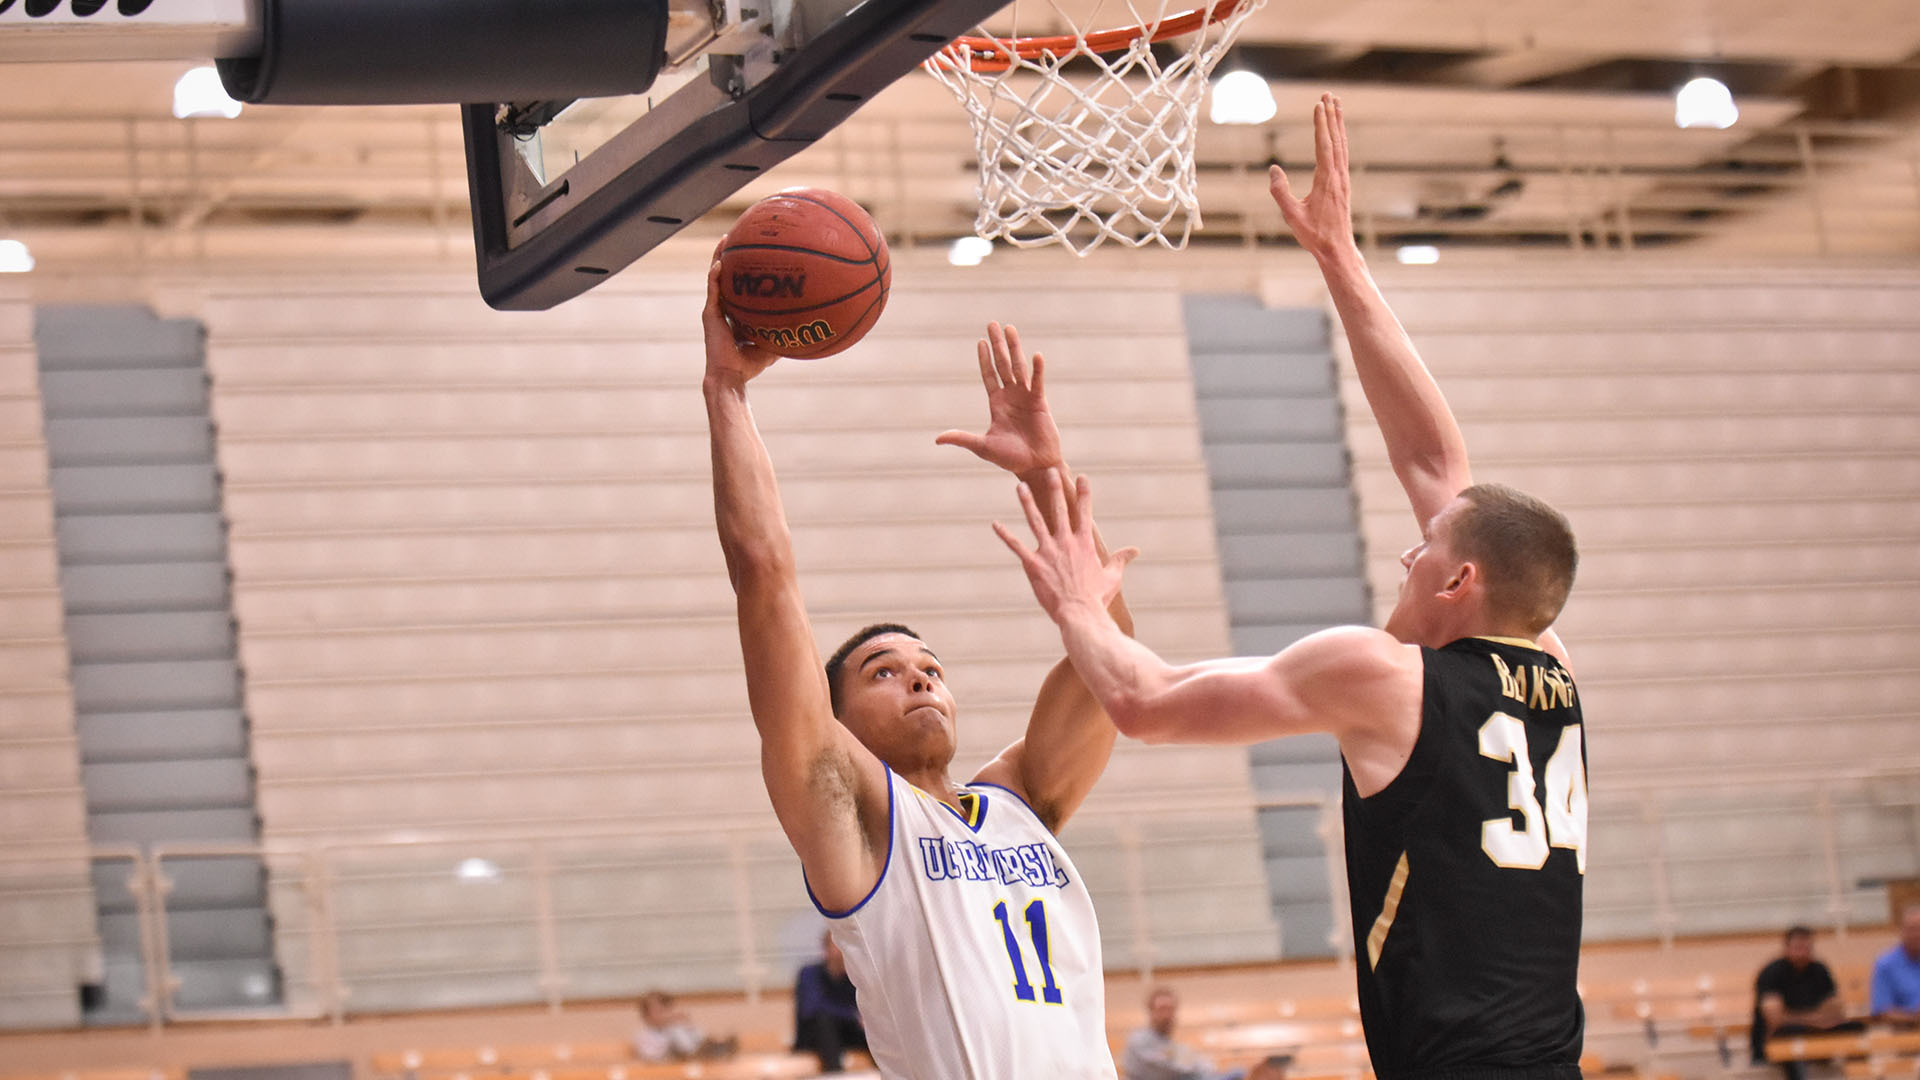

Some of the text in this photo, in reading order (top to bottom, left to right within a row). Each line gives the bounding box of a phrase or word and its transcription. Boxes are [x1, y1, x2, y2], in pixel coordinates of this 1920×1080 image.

[732, 272, 806, 299] NCAA
[1478, 711, 1588, 875] 34
[993, 897, 1064, 1006] 11
